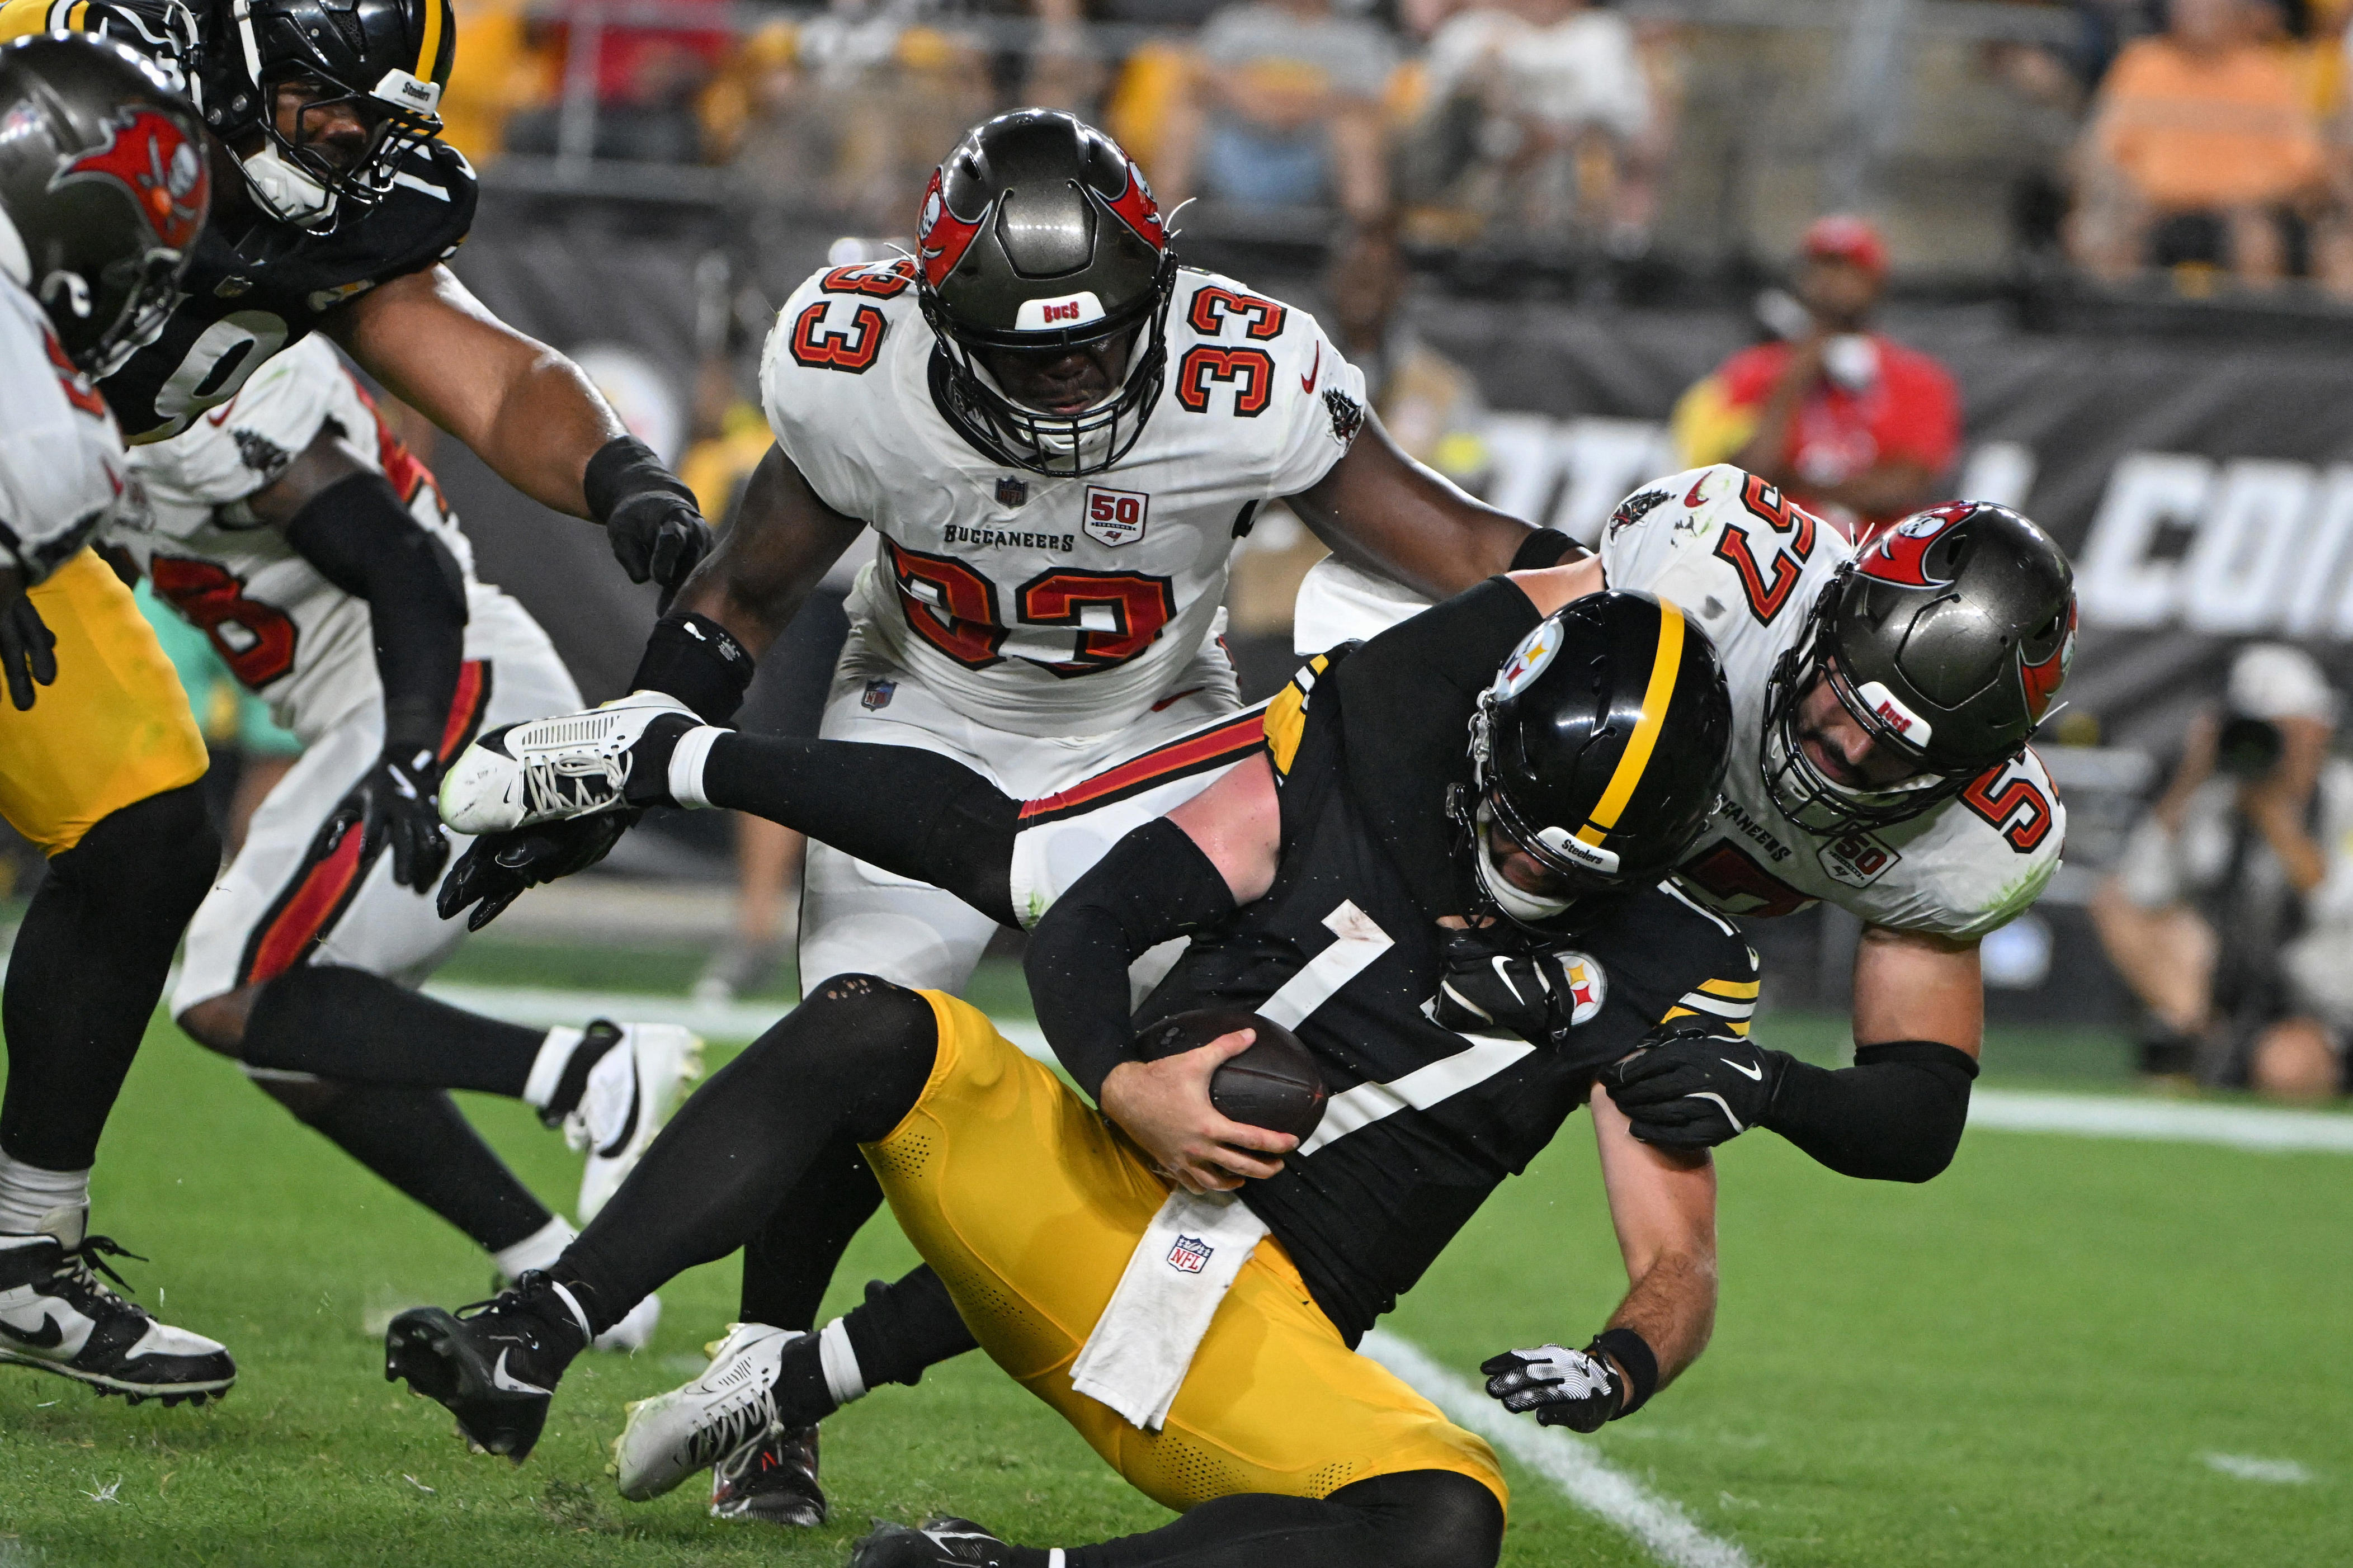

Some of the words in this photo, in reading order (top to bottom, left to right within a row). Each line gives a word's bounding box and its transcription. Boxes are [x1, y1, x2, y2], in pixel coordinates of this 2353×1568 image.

[789, 259, 917, 375] 33
[1175, 285, 1288, 417] 33
[1091, 494, 1140, 525] 50
[944, 525, 1074, 551] BUCCANEERS
[1713, 473, 1816, 627] 57
[1955, 744, 2060, 854] 5
[1561, 839, 1603, 864] Steelers
[1835, 833, 1887, 875] 50
[1170, 1248, 1201, 1271] NFL
